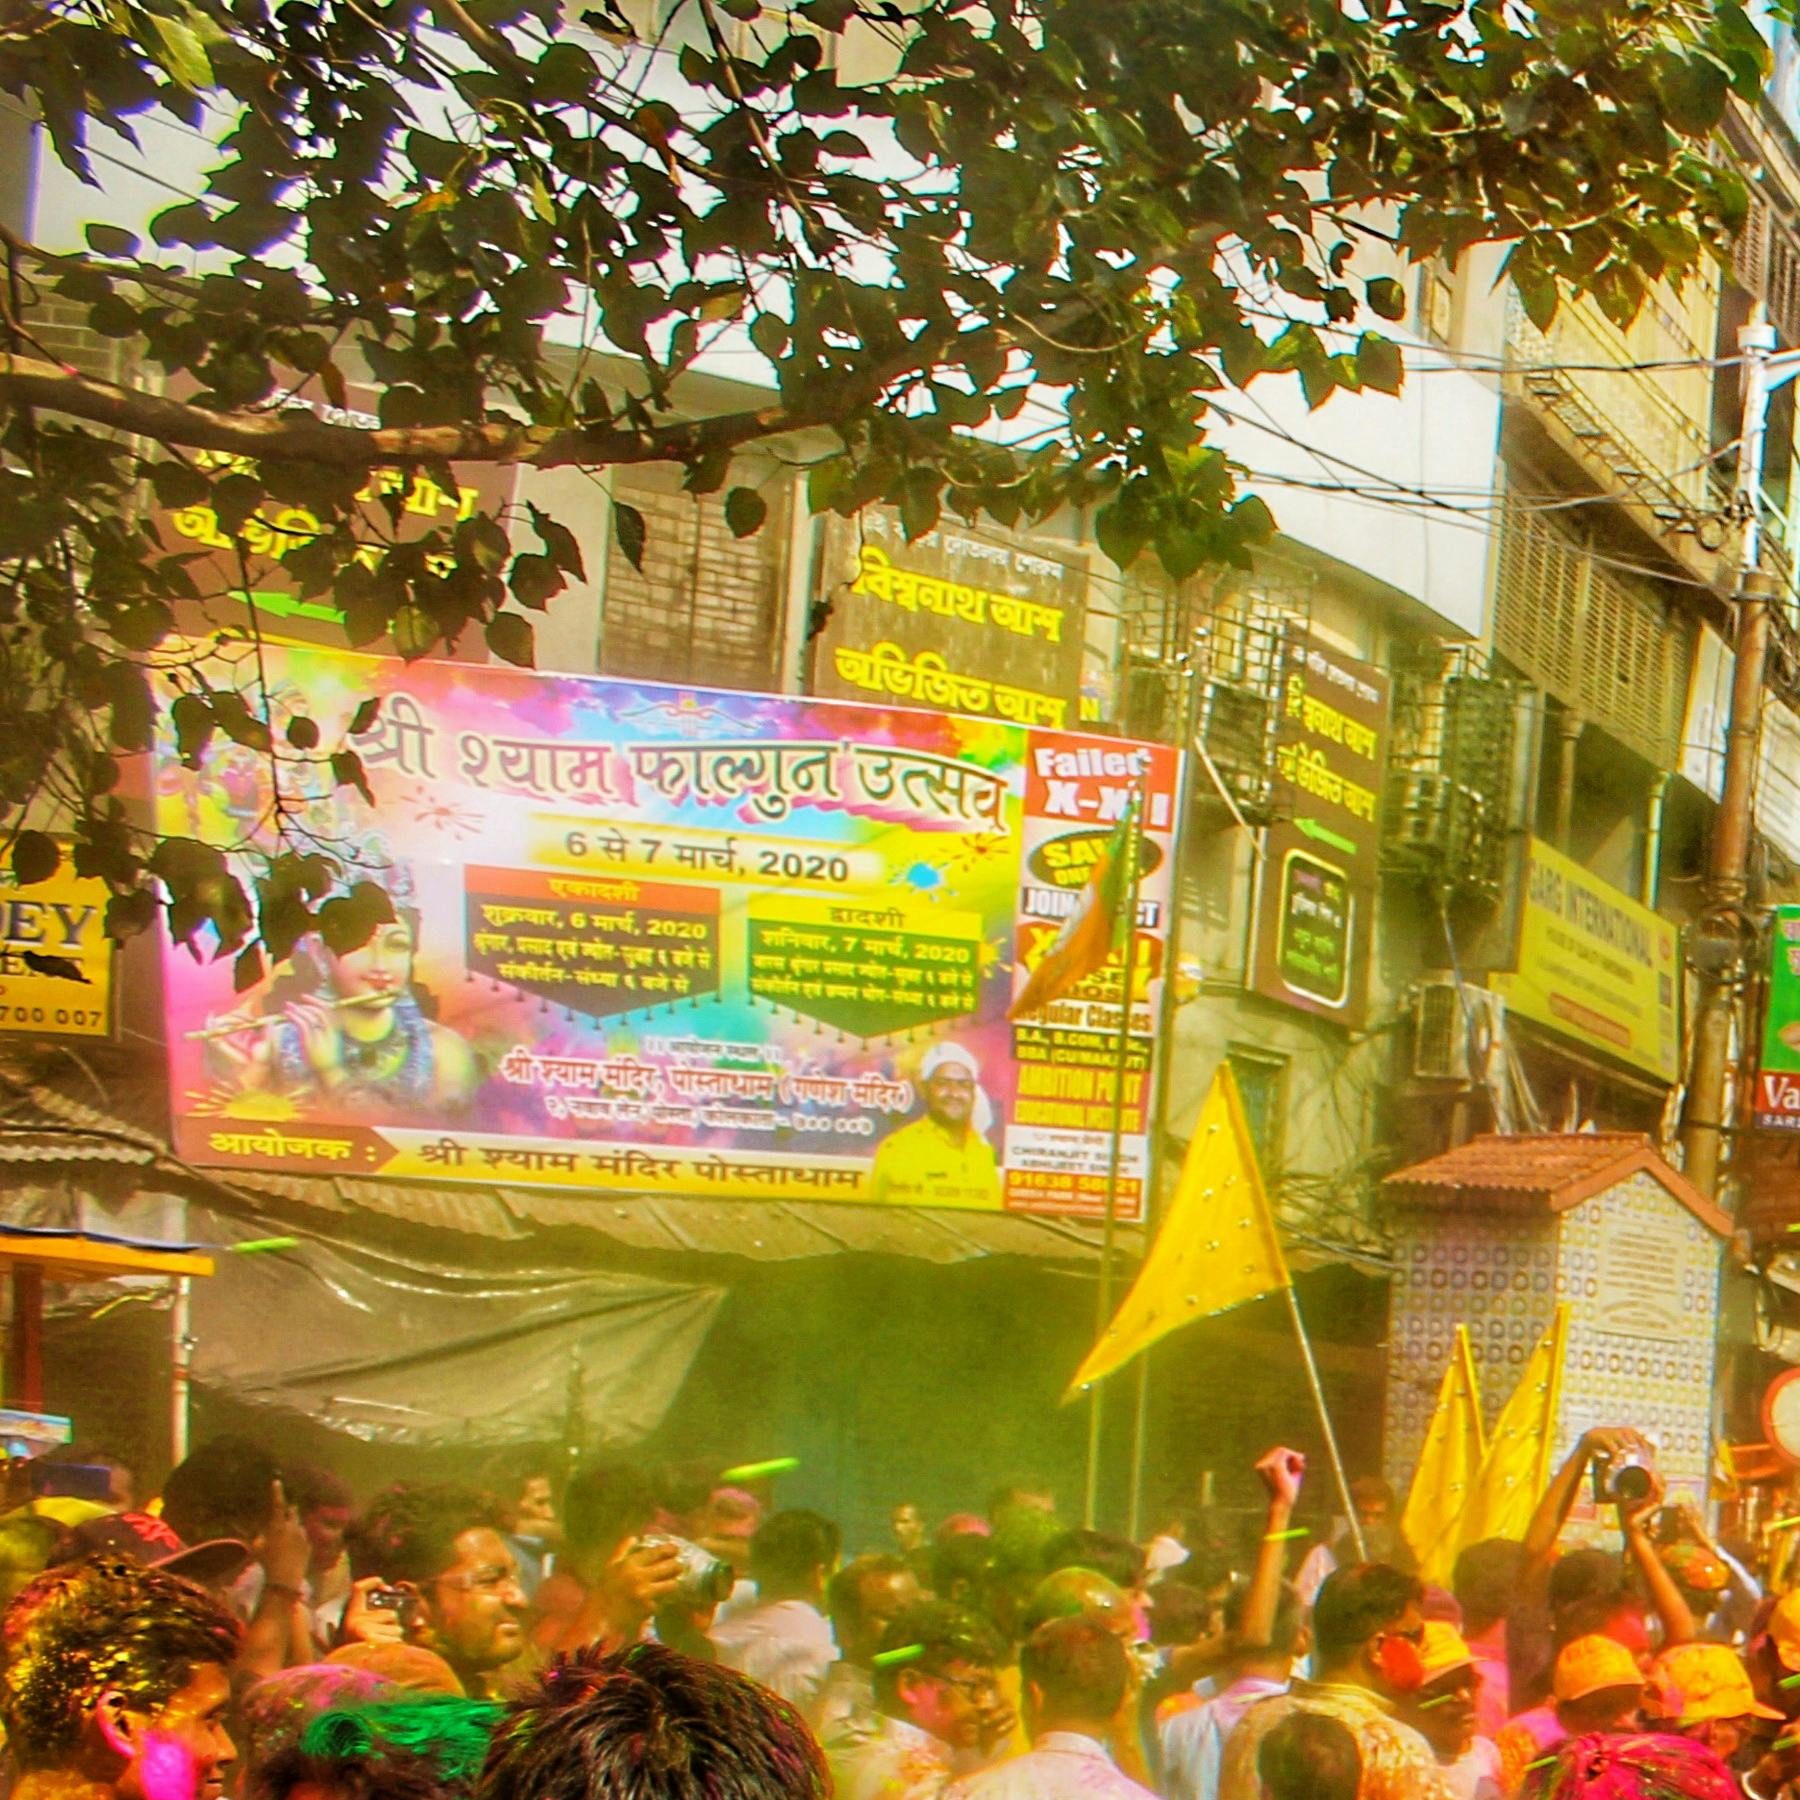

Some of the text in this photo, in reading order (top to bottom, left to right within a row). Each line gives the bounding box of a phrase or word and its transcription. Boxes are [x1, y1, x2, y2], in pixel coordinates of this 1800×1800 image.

[352, 693, 1009, 832] श्री श्याम फाल्गुन उत्सव
[1045, 780, 1169, 826] X-XI
[566, 828, 848, 882] 6 से 7 मार्च, 2020
[1043, 838, 1110, 868] SAV
[570, 912, 586, 928] 6
[647, 919, 706, 939] 2020
[842, 937, 857, 952] 7
[914, 942, 970, 964] 2020
[1087, 1004, 1152, 1032] Clases
[209, 1128, 353, 1160] आयोजक
[420, 1137, 467, 1168] श्री
[478, 1147, 575, 1172] श्याम
[588, 1149, 683, 1181] मंदिर
[694, 1154, 863, 1190] पोस्ताधाम
